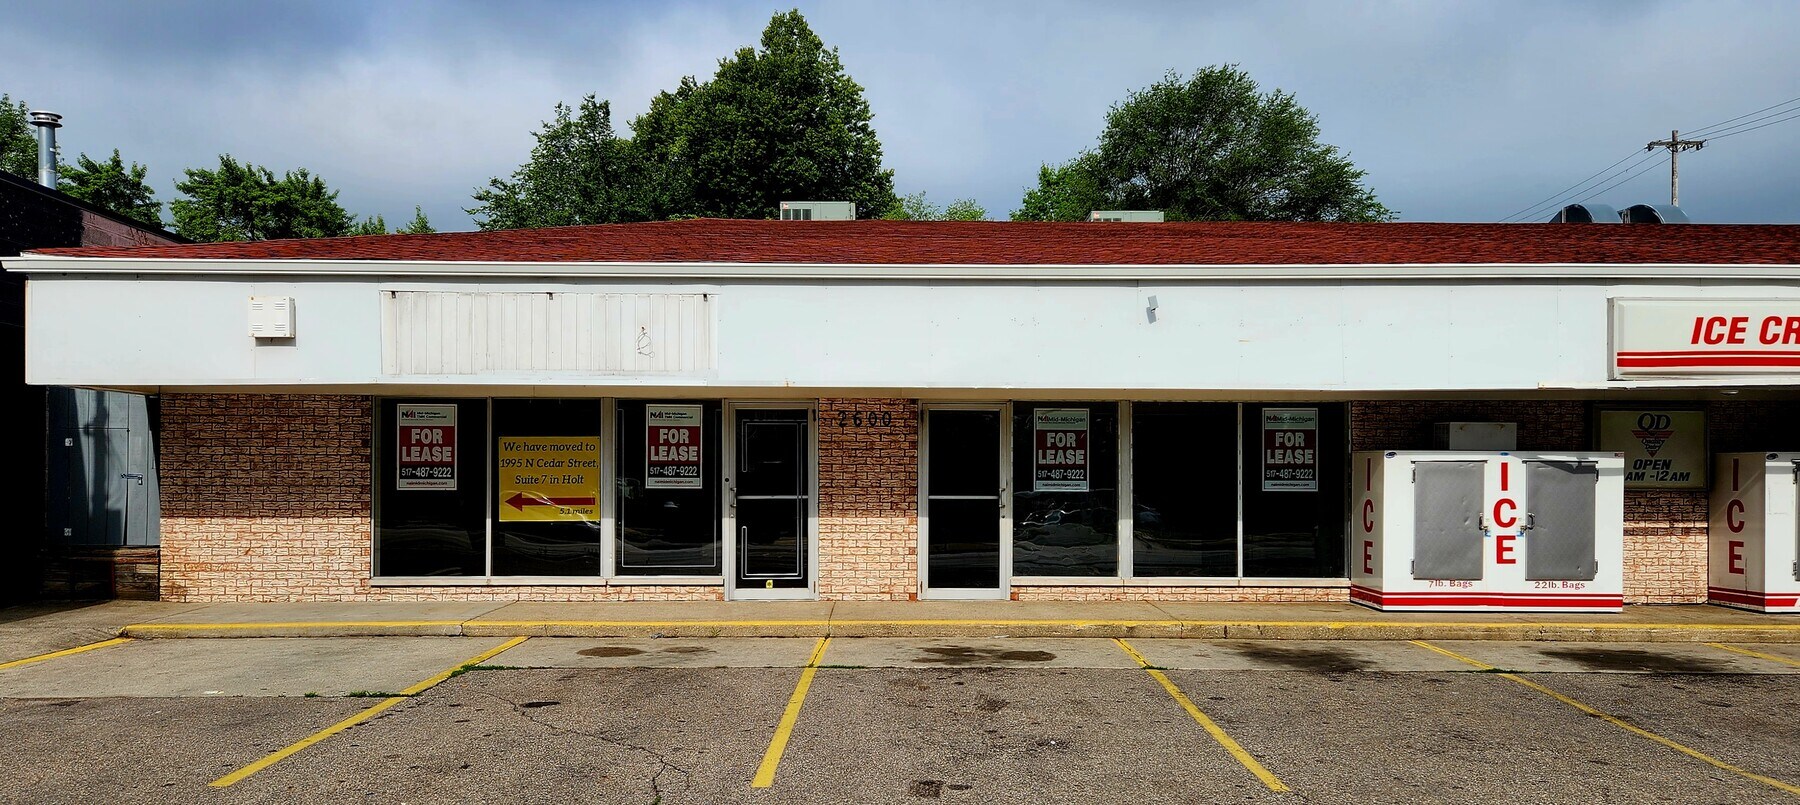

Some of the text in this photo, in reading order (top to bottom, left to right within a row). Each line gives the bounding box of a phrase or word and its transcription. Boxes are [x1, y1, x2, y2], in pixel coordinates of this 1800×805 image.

[1691, 316, 1749, 344] ICE
[838, 411, 891, 427] 2600
[1637, 413, 1671, 432] QD
[412, 429, 443, 444] FOR
[660, 429, 689, 443] FOR
[1047, 433, 1076, 447] FOR
[1275, 432, 1304, 447] FOR
[503, 442, 596, 451] We have moved to
[650, 446, 698, 461] LEASE
[402, 446, 452, 462] LEASE
[1038, 450, 1084, 464] LEASE
[1267, 449, 1313, 464] LEASE
[500, 459, 599, 469] 1995 N Cedar Street,
[650, 466, 697, 475] 517-487-9222
[1633, 459, 1672, 470] OPEN
[401, 467, 452, 478] 517-487-9222
[515, 474, 584, 484] Suite 7 in Holt
[1038, 469, 1084, 479] 517-487-9222
[1266, 469, 1313, 478] 517-487-9222
[1363, 458, 1374, 575] ICE
[1493, 462, 1517, 565] ICE
[1726, 458, 1745, 575] ICE
[1449, 580, 1473, 589] Bags
[1534, 581, 1585, 590] 22lb. Bags
